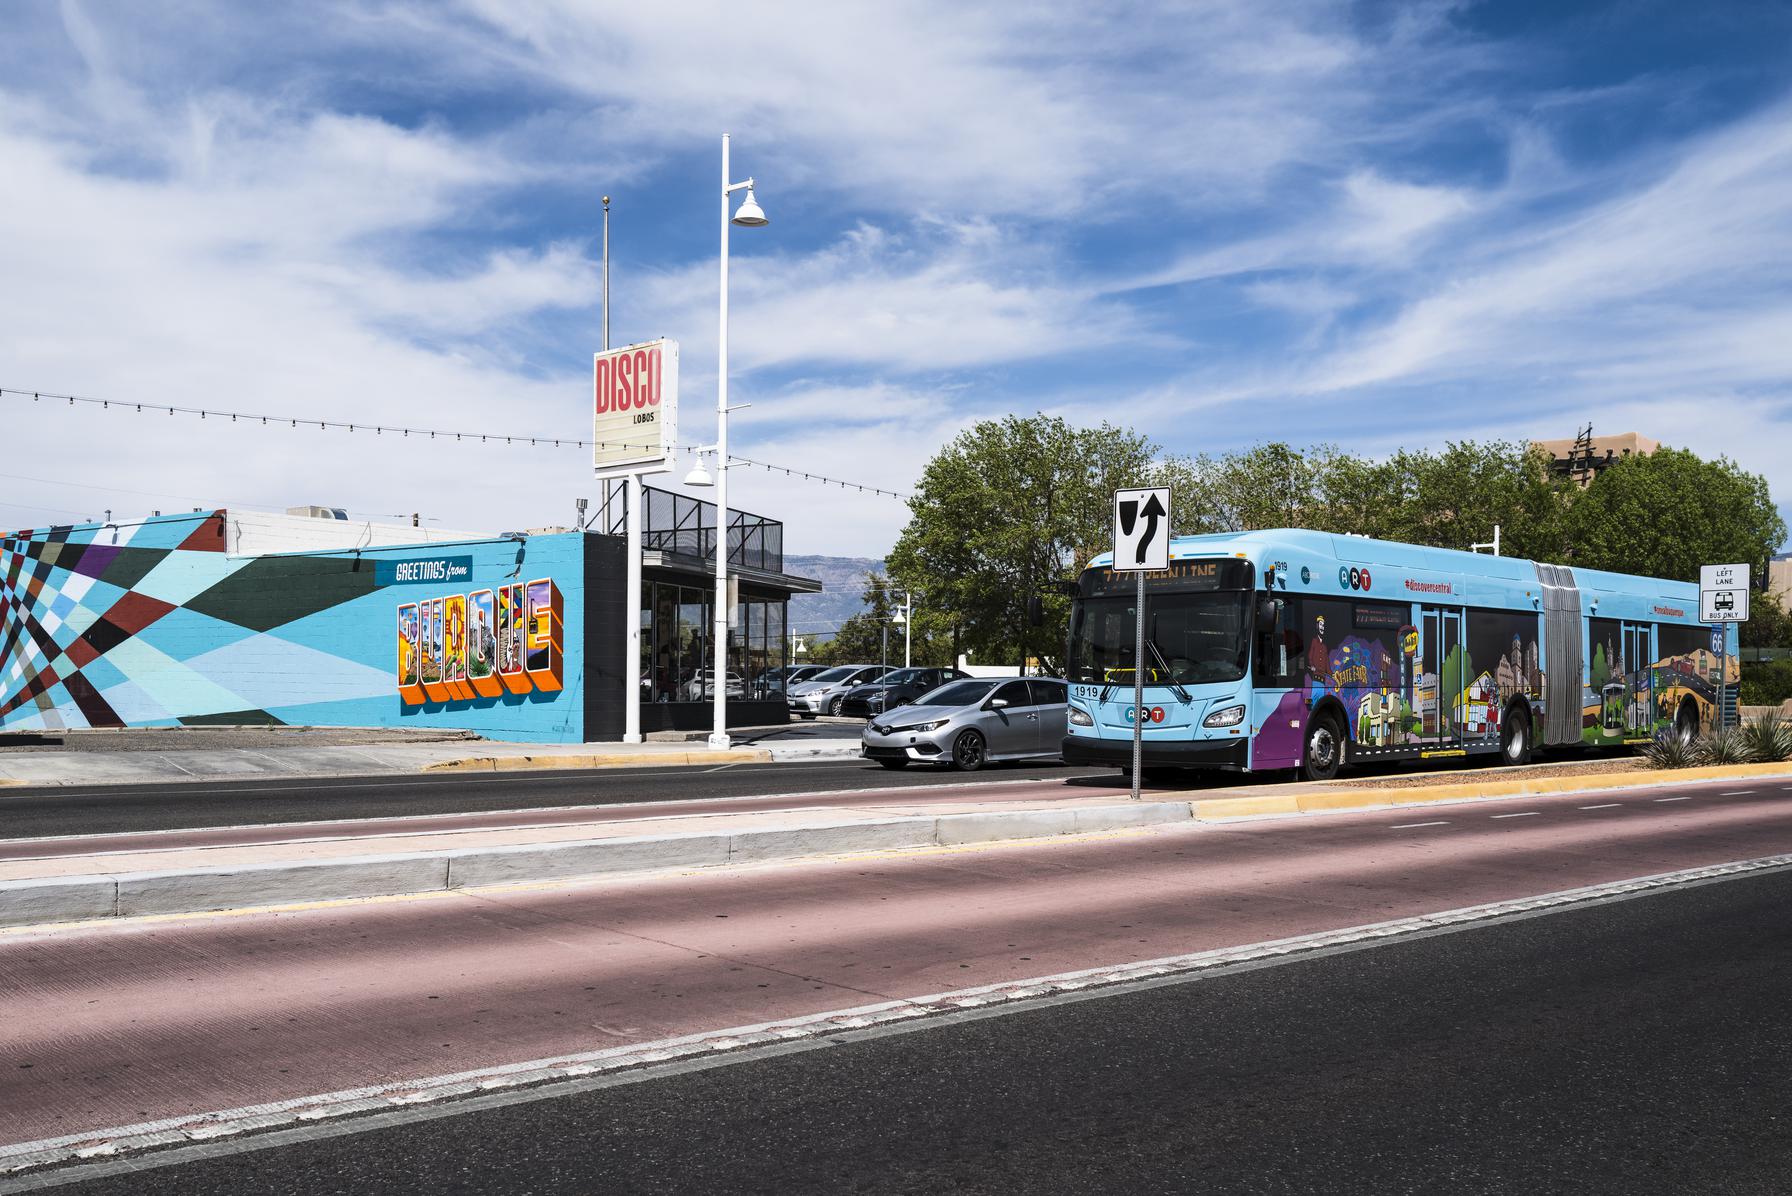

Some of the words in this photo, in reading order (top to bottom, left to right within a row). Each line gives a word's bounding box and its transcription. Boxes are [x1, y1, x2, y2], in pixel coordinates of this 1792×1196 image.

[596, 349, 661, 414] DISCO
[633, 412, 655, 424] LOBOS
[396, 561, 445, 581] GREETINGS
[446, 562, 467, 580] from
[1275, 561, 1288, 571] 1919
[1340, 568, 1370, 588] ART
[1723, 611, 1738, 619] ONLY
[397, 577, 559, 697] BURQUE
[1712, 633, 1723, 652] 66
[1075, 686, 1098, 697] 1919
[1126, 708, 1163, 721] ART
